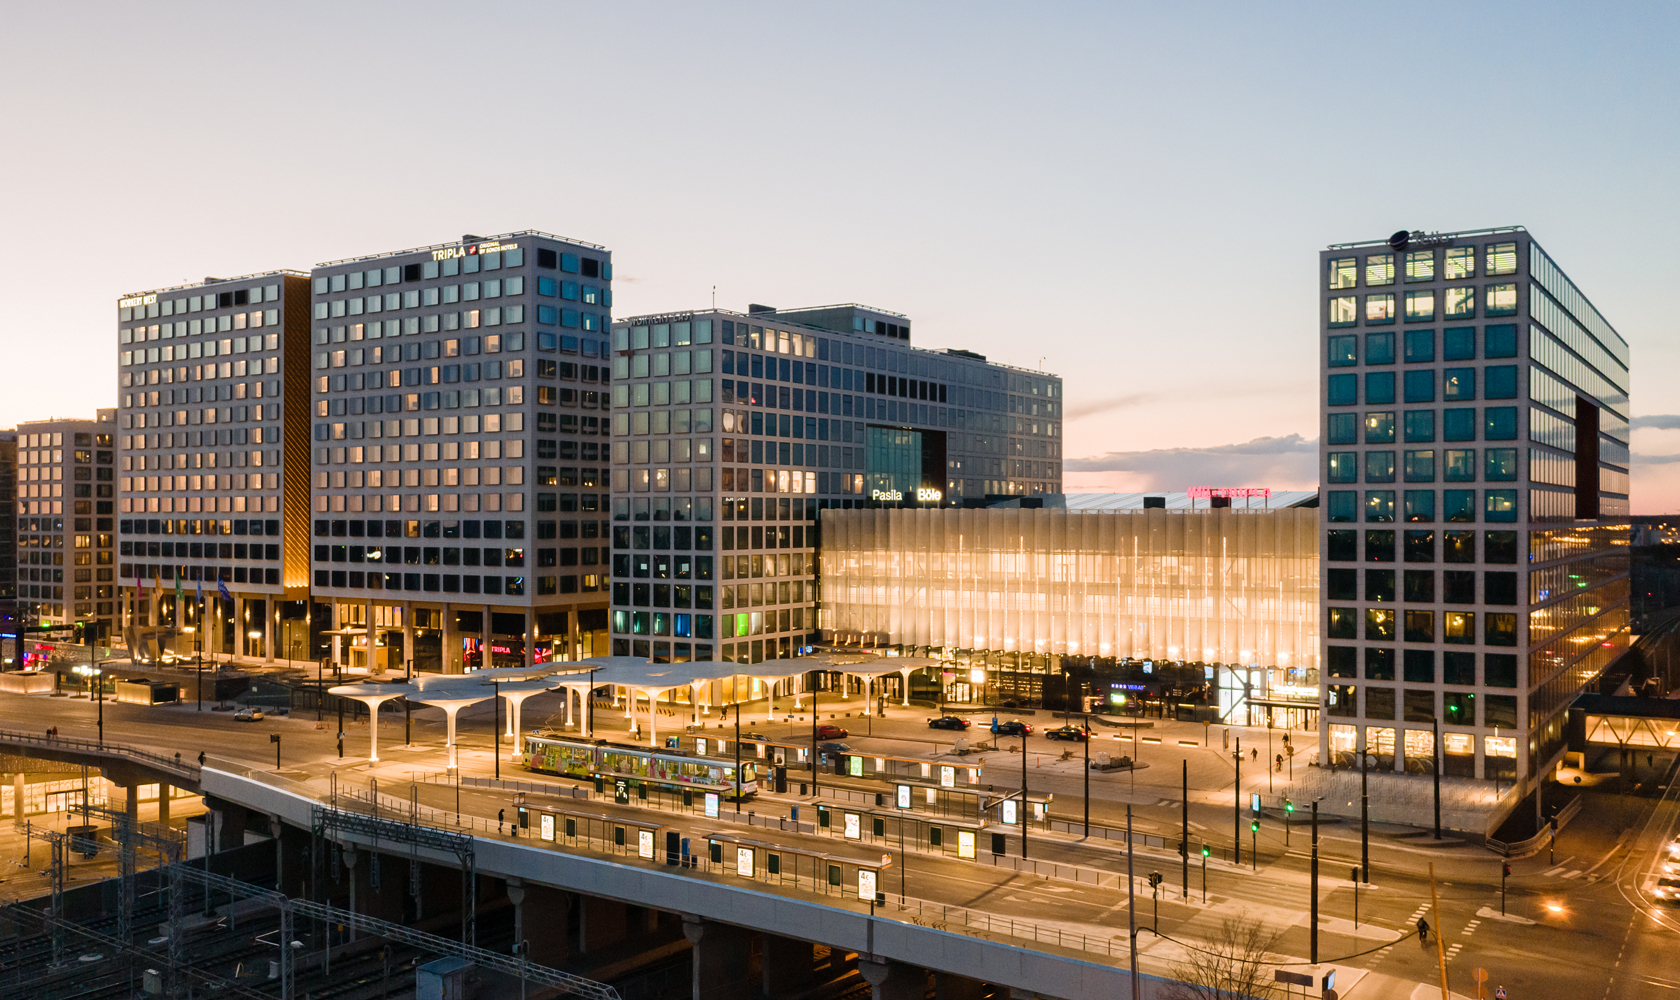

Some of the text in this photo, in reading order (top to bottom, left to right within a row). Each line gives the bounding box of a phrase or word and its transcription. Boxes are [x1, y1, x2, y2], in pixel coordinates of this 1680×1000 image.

[501, 243, 518, 251] HOTELS
[432, 246, 466, 261] TRIPLA
[873, 488, 942, 501] Pasila Böle
[1218, 487, 1273, 499] TRIPLA
